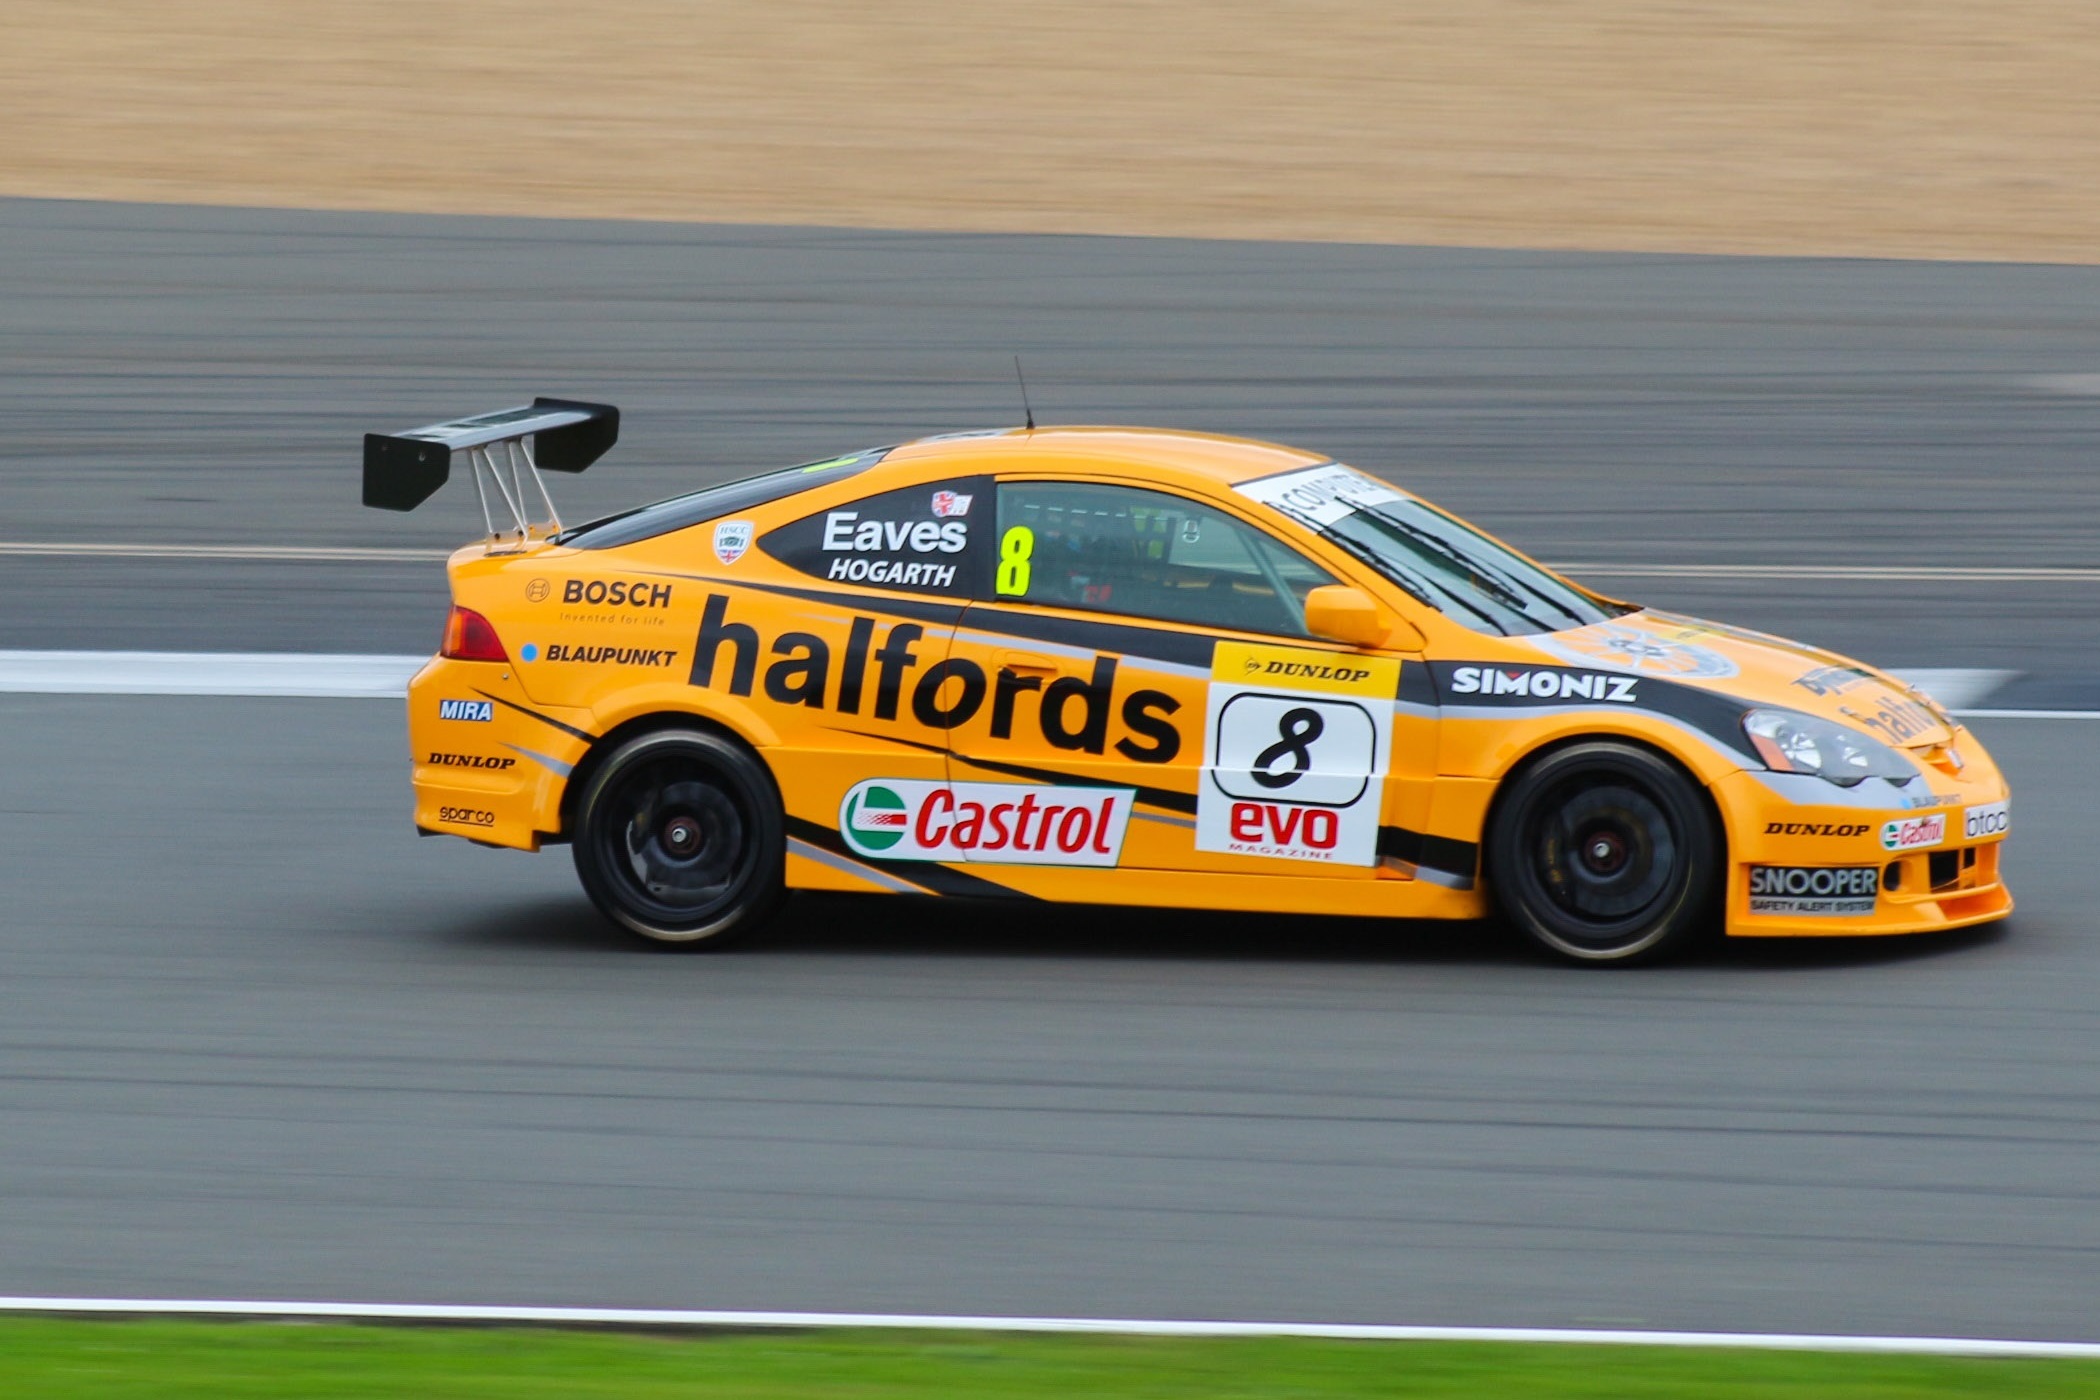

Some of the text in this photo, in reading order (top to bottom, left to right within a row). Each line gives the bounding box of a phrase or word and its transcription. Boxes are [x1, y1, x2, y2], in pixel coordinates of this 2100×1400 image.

[822, 512, 967, 553] Eaves
[828, 558, 956, 588] HOGARTH
[995, 525, 1035, 597] 8
[563, 579, 672, 609] BOSCH
[560, 612, 665, 626] Invented for life
[546, 645, 678, 667] BLAUPUNKT
[688, 594, 1182, 764] halfords
[1264, 661, 1370, 683] DUNLOP
[1451, 666, 1639, 703] SIMONIZ
[440, 700, 492, 721] MIRA
[428, 752, 516, 770] DUNLOP
[1250, 707, 1324, 789] 8
[439, 806, 495, 824] sparco
[914, 788, 1116, 854] Castrol
[1230, 802, 1338, 850] evo
[1967, 809, 2007, 837] btcc
[1764, 822, 1870, 837] DUNLOP
[1229, 843, 1333, 860] MAGAZINE
[1750, 867, 1878, 895] SNOOPER
